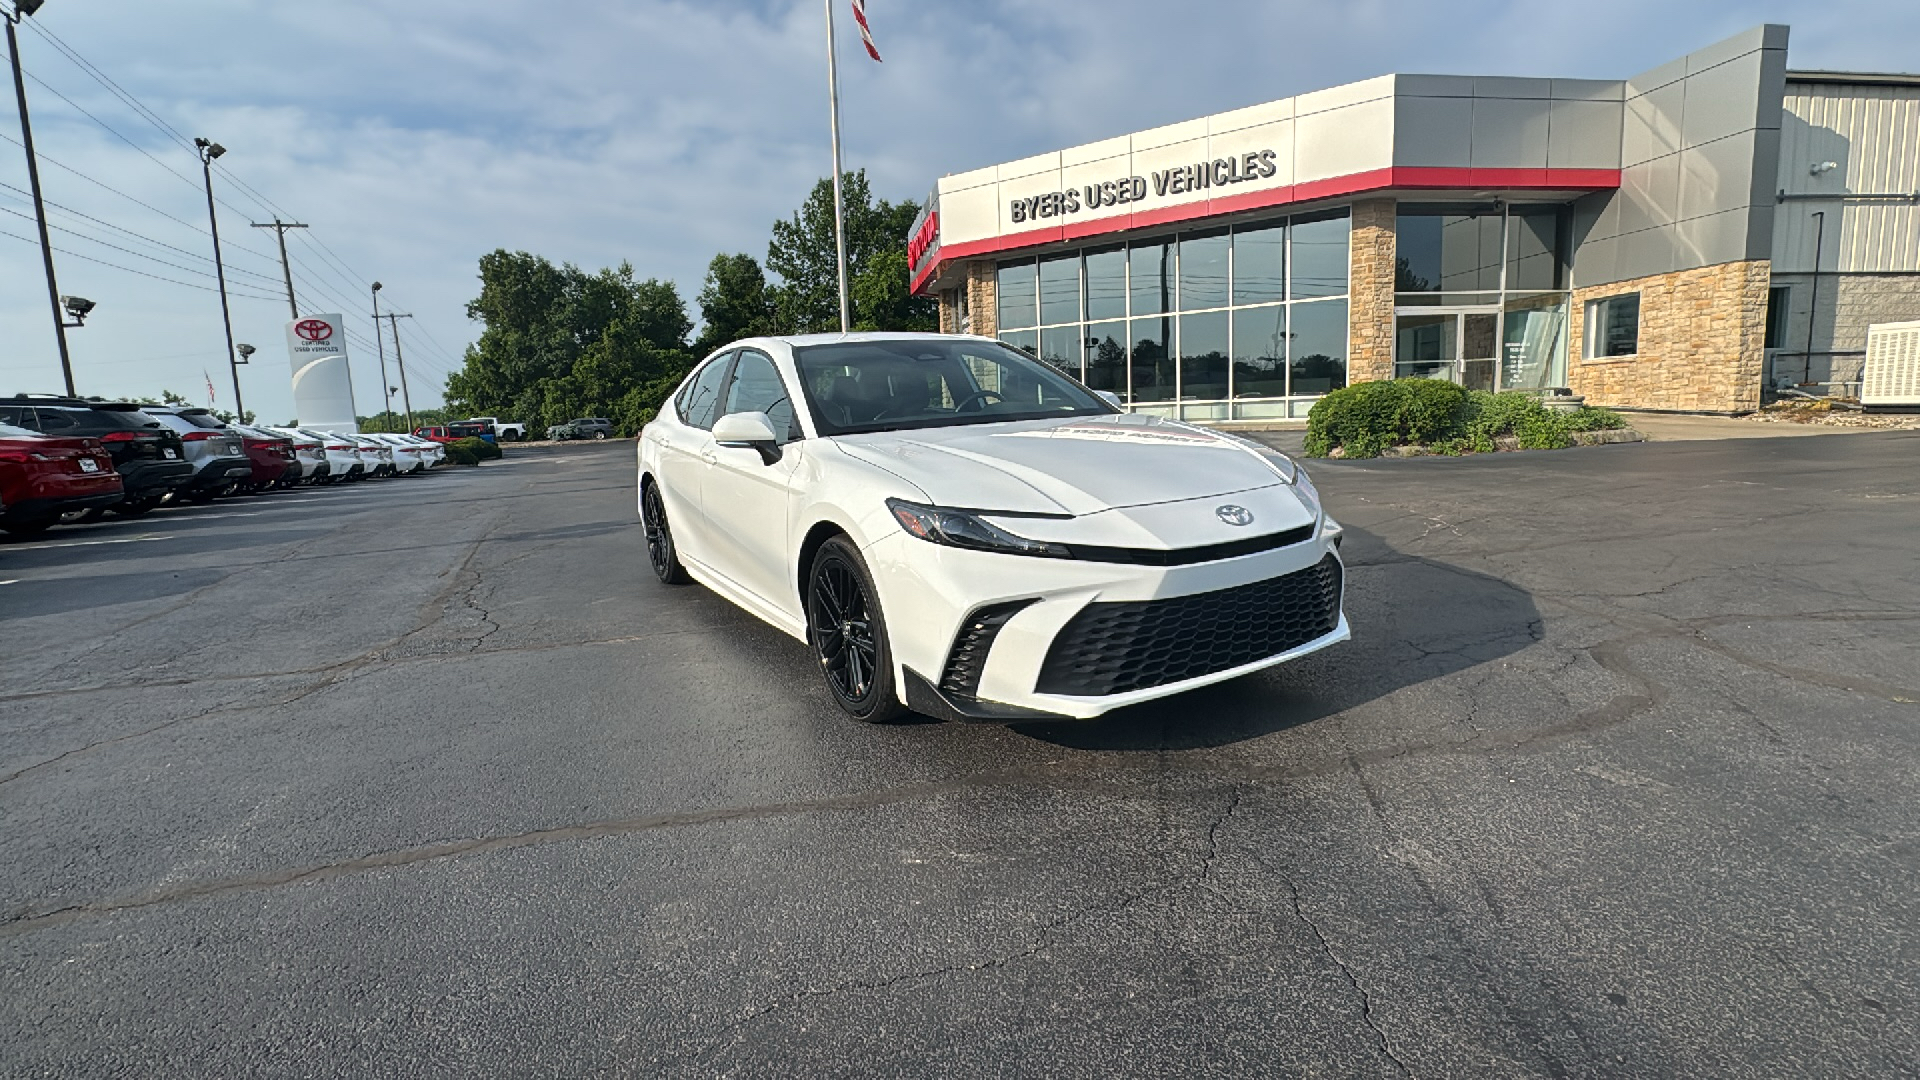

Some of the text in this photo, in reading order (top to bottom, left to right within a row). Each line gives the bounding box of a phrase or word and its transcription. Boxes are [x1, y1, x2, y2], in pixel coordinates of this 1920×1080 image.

[1011, 149, 1276, 223] BYERS USED VEHICLES
